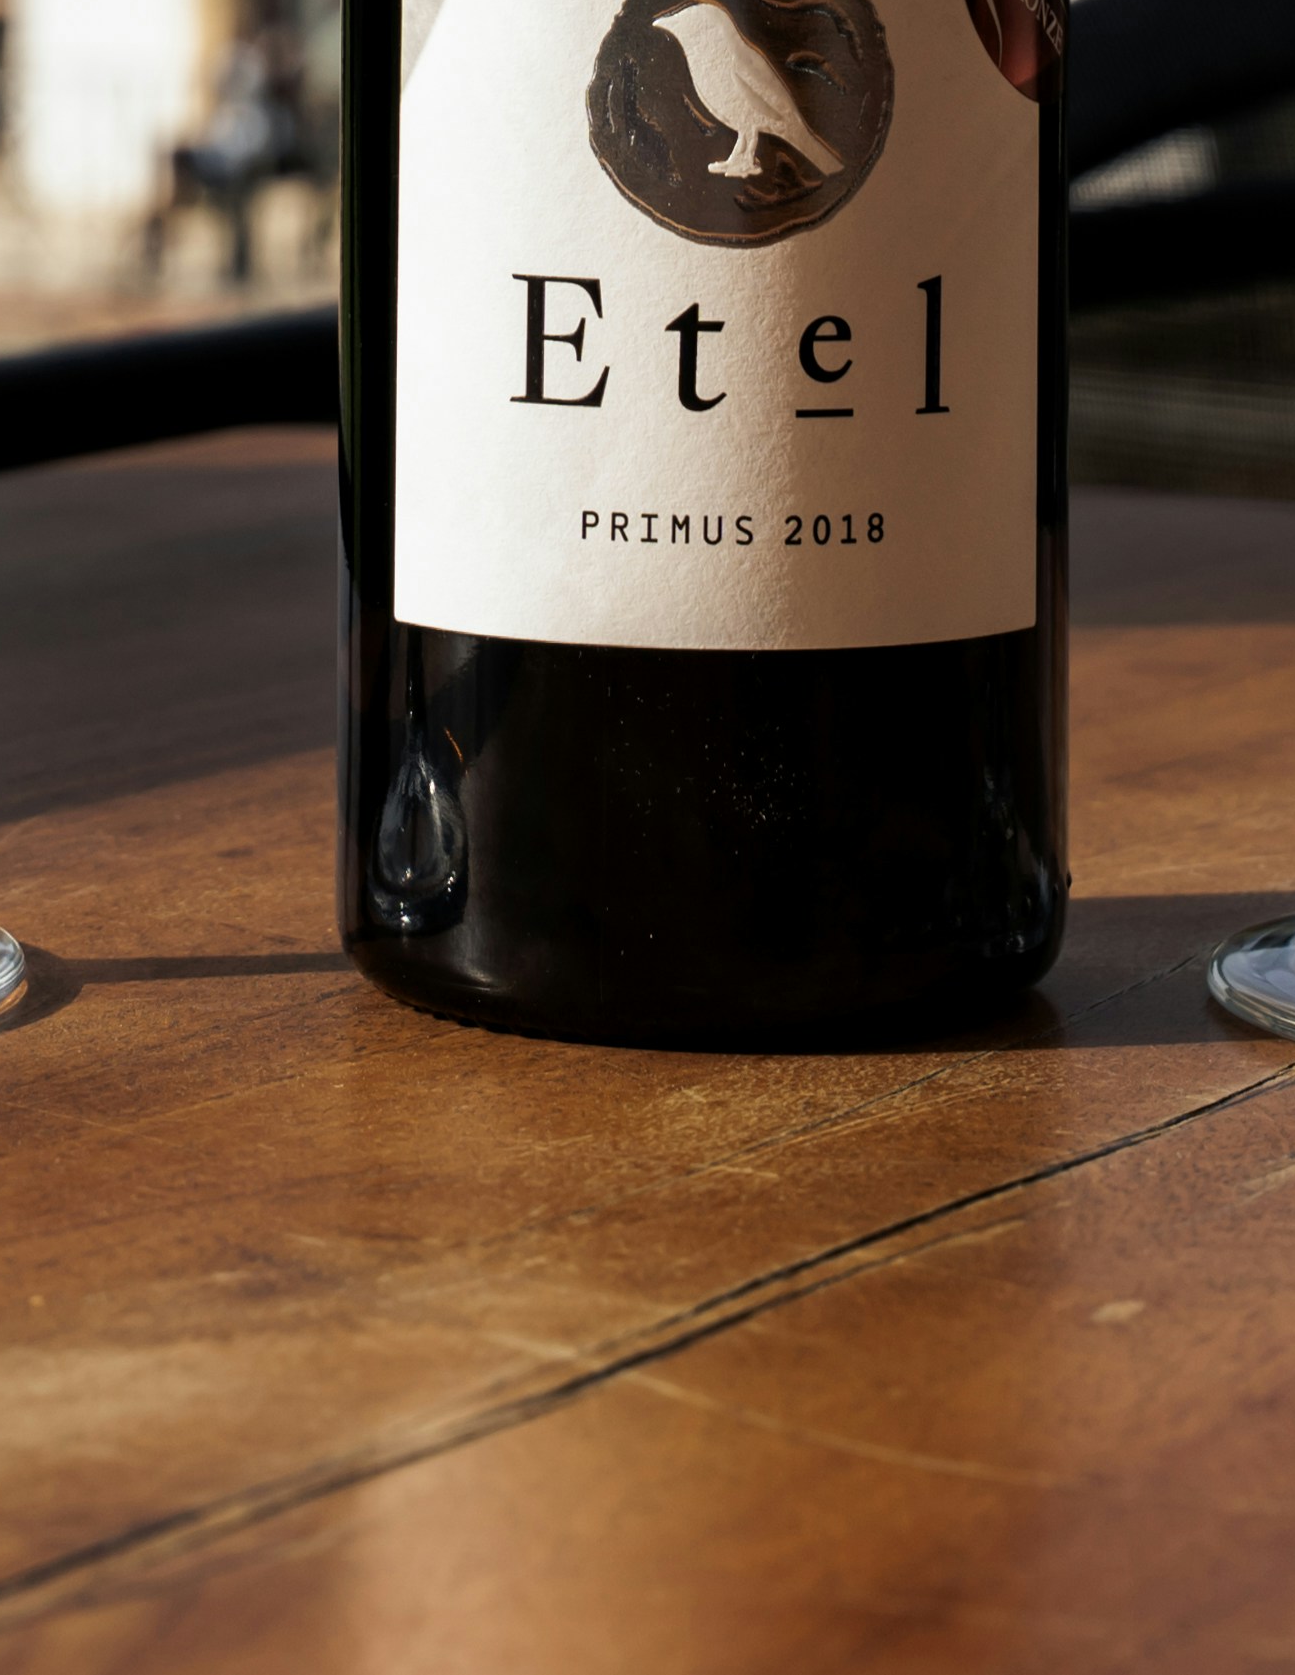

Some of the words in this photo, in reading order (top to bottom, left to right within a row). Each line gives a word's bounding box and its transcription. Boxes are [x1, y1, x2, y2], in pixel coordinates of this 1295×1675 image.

[509, 272, 951, 418] Etel
[581, 510, 755, 546] PRIMUS
[784, 512, 885, 546] 2018
